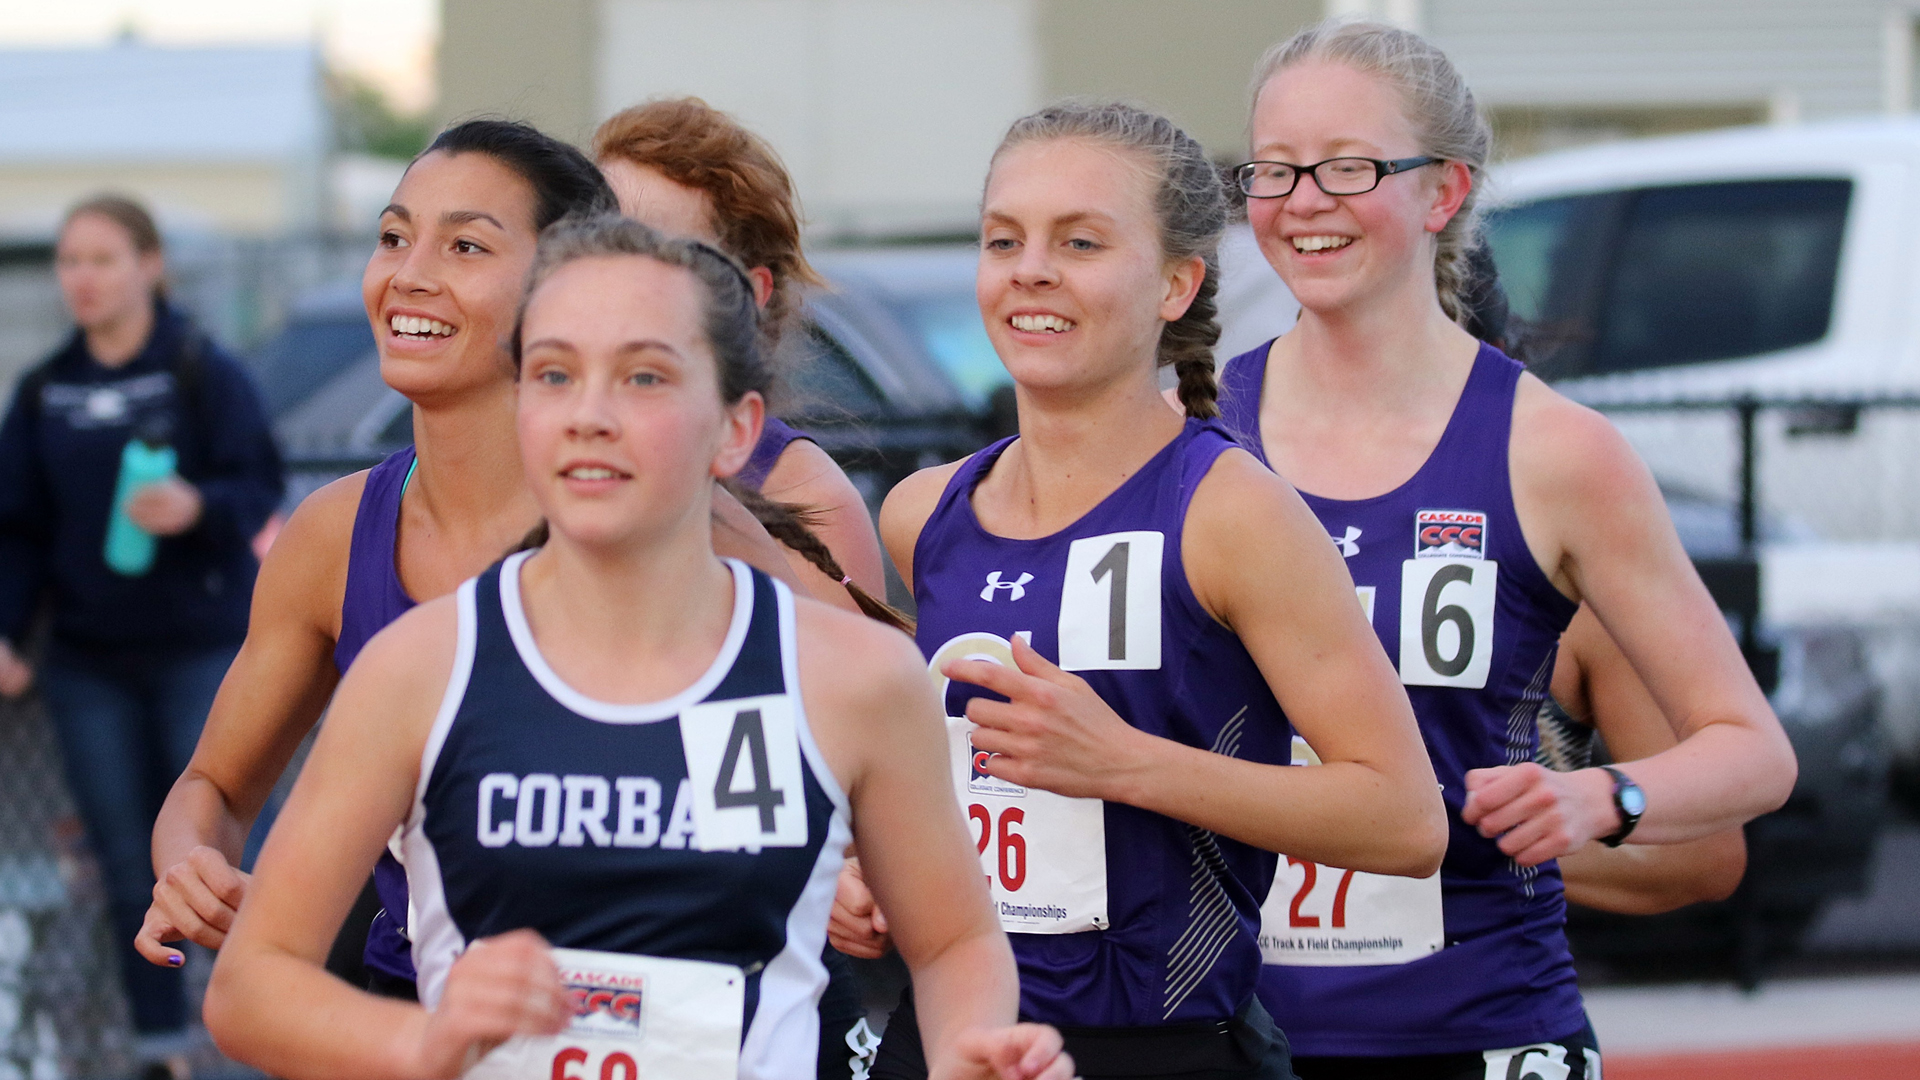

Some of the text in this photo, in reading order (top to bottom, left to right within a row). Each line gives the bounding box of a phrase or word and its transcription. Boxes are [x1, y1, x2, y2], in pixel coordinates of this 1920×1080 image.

[1419, 513, 1483, 523] CASCADE
[1420, 525, 1482, 547] CCC
[1090, 541, 1130, 660] 1
[1421, 564, 1475, 677] 6
[713, 708, 785, 834] 4
[477, 773, 761, 854] CORBA
[968, 803, 1027, 893] 26
[1001, 902, 1067, 921] Championships
[1273, 936, 1295, 950] Track
[1298, 937, 1305, 950] &
[1307, 937, 1329, 950] Field
[1332, 936, 1403, 953] Championships
